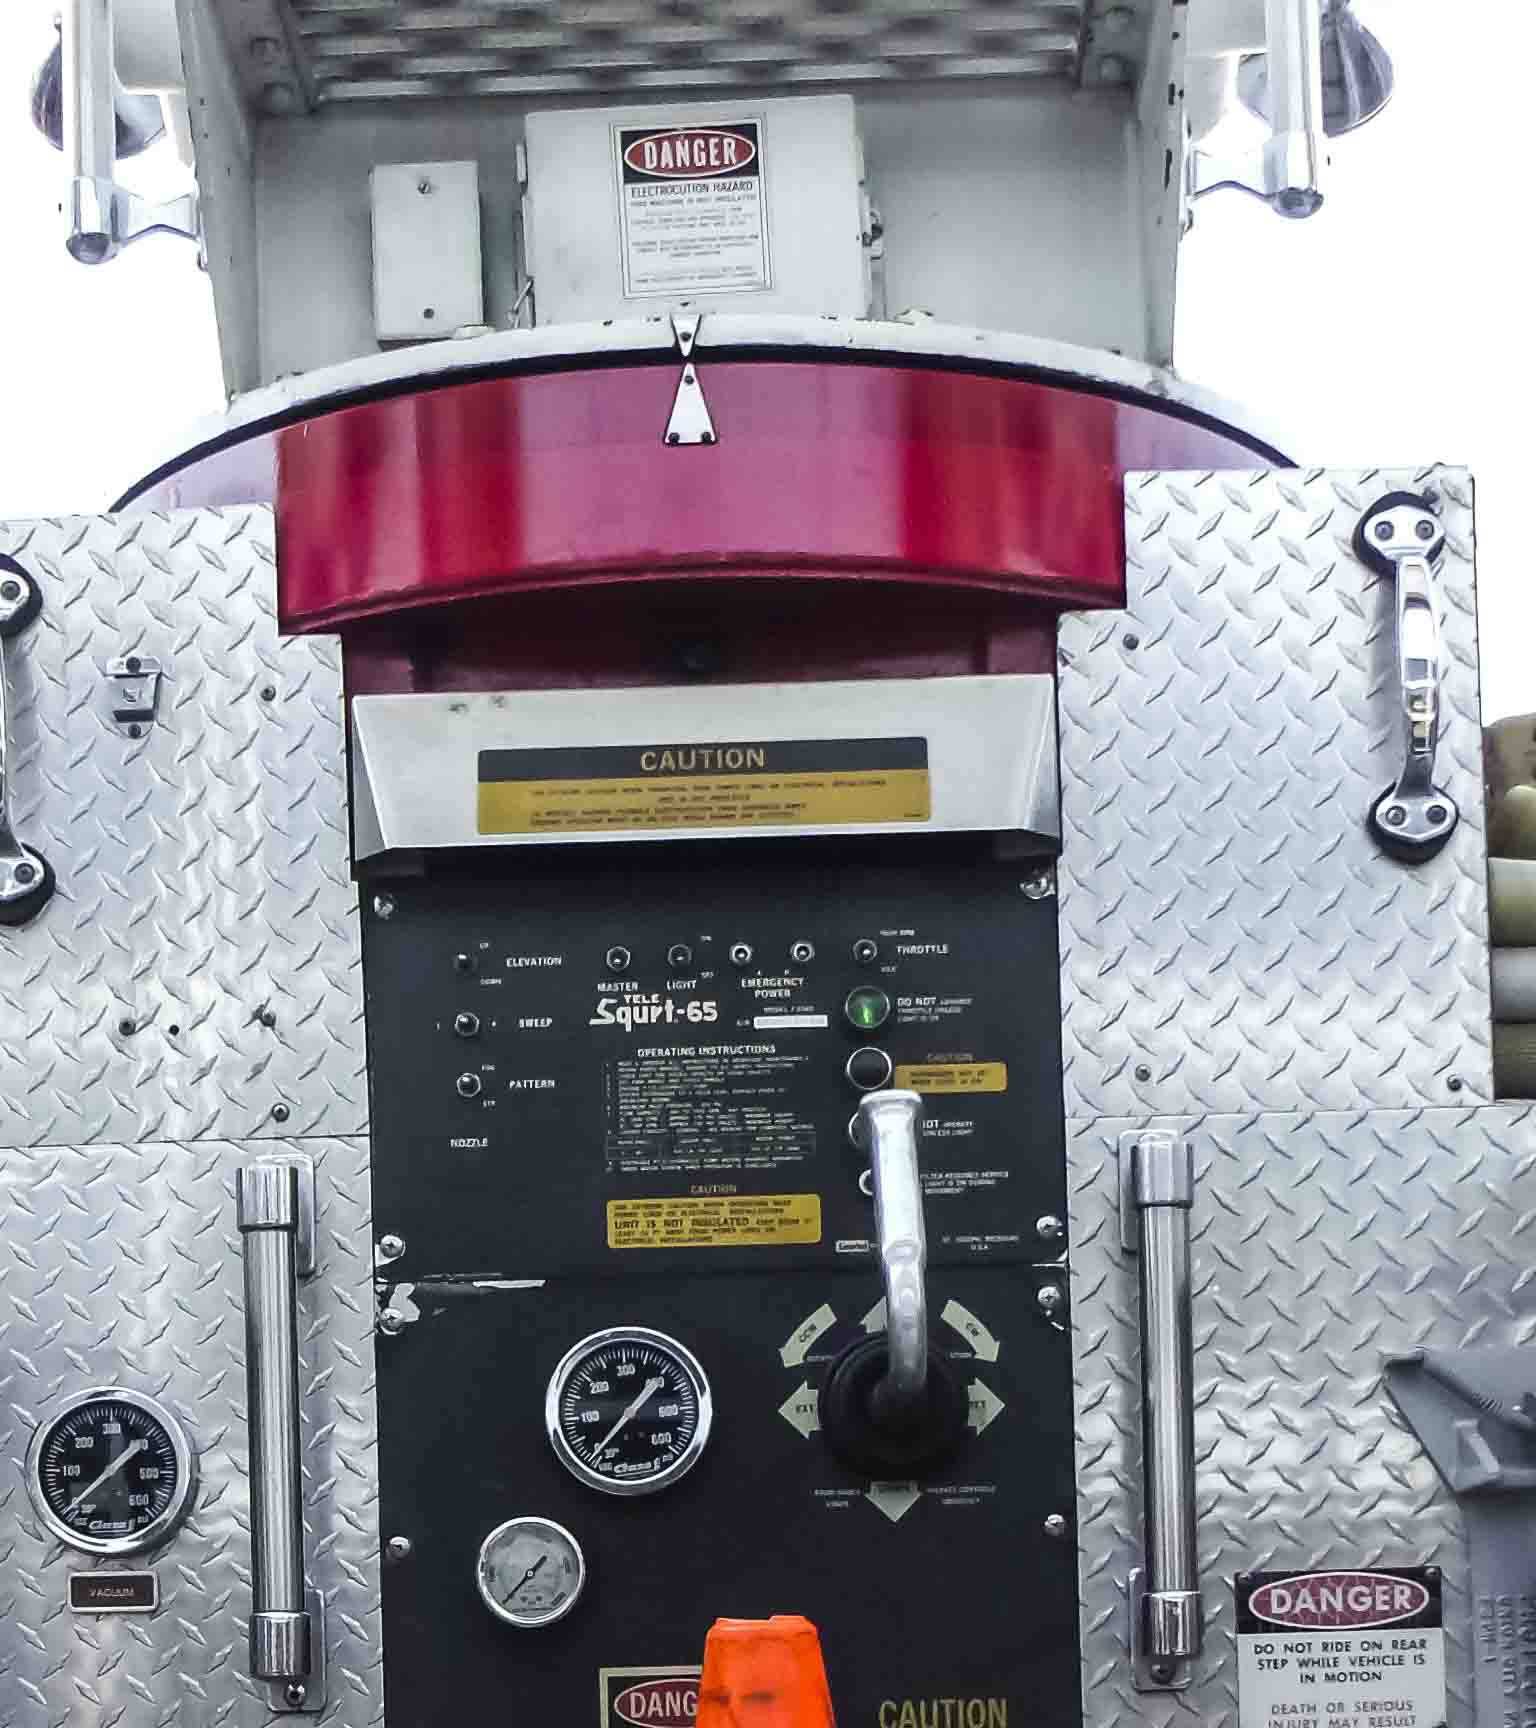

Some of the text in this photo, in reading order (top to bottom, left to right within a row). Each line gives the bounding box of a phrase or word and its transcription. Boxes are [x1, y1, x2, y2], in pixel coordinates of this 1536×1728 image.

[644, 138, 737, 169] DANGER
[631, 180, 753, 198] ELECTROCUTION HAZARD
[640, 748, 766, 772] CAUTION
[897, 944, 949, 954] THROTTLE
[506, 957, 562, 967] ELEVATION
[597, 981, 638, 992] MASTER
[667, 979, 697, 990] LIGHT
[741, 976, 804, 988] EMERGENCY
[624, 993, 660, 1004] TELE
[754, 989, 791, 998] POWER
[897, 997, 912, 1006] DO
[915, 997, 937, 1006] NOT
[519, 1017, 553, 1028] SWEEP
[637, 1044, 776, 1058] OPERATING INSTRUCTIONS
[509, 1079, 555, 1089] PATTERN
[450, 1137, 489, 1148] NOZZLE
[690, 1184, 738, 1194] CAUTION
[663, 1218, 684, 1229] NOT
[616, 1364, 636, 1377] 300
[589, 1381, 610, 1394] 200
[581, 1410, 600, 1422] 100
[74, 1436, 95, 1449] 200
[63, 1464, 81, 1477] 100
[139, 1467, 159, 1480] 500
[128, 1494, 149, 1506] 600
[1270, 1585, 1413, 1615] DANGER
[1254, 1638, 1427, 1654] DO NOT RIDE ON REAR
[1257, 1654, 1426, 1670] STEP WHILE VEHICLE IS
[1300, 1671, 1383, 1684] IN MOTION
[630, 1690, 698, 1719] DANG
[1271, 1699, 1414, 1715] DEATH OR SERIOUS
[1328, 1716, 1361, 1728] MAY
[1368, 1714, 1418, 1728] RESULT
